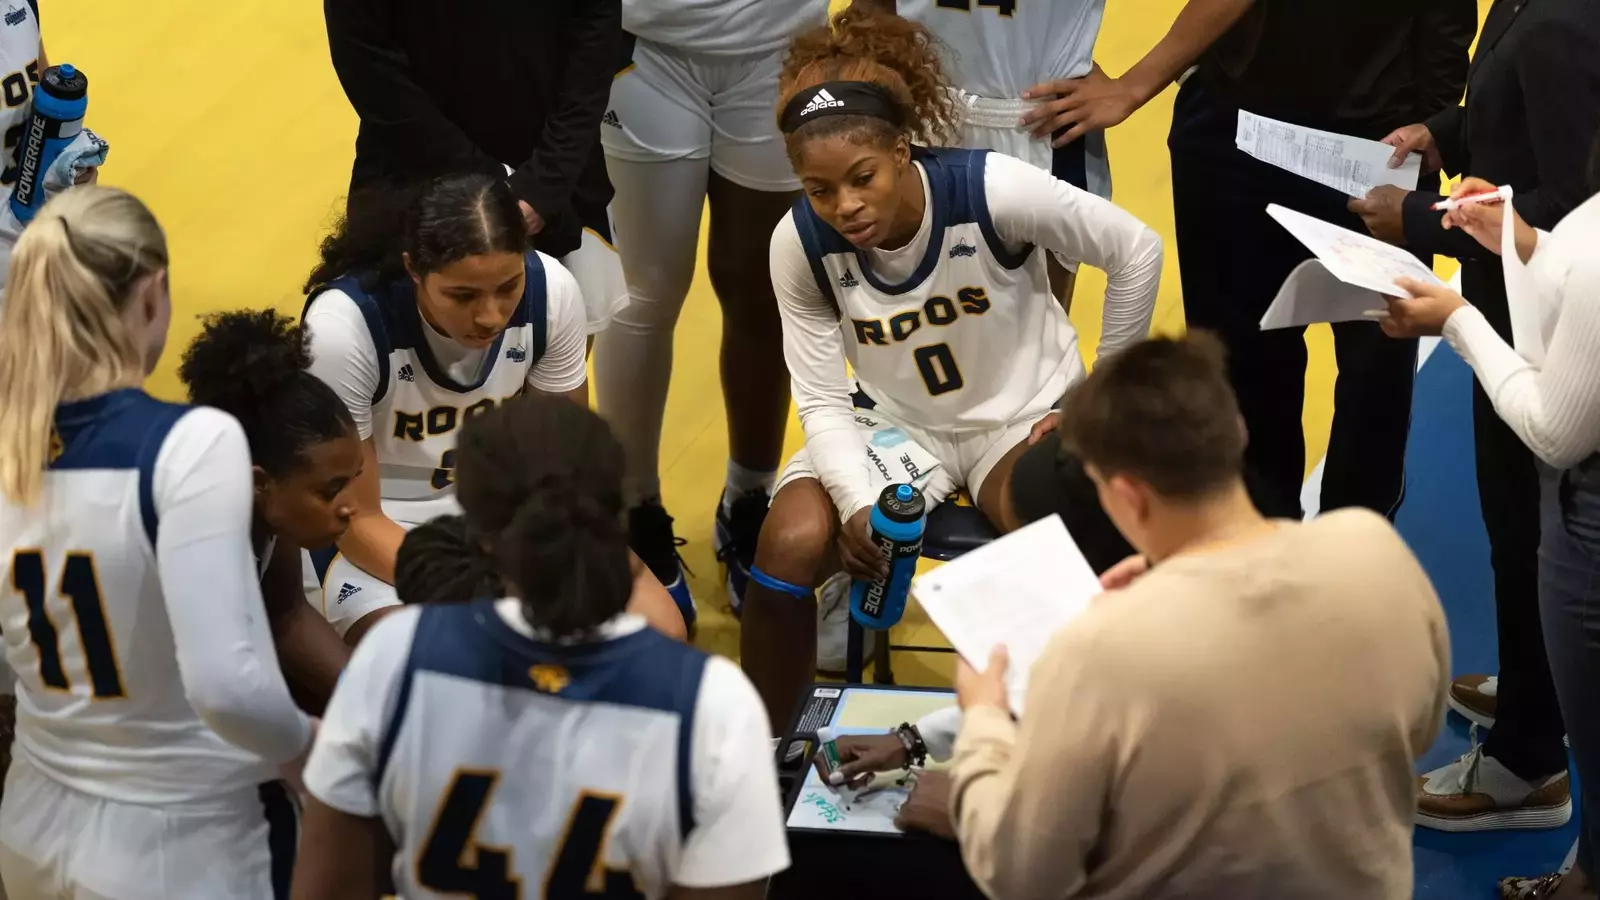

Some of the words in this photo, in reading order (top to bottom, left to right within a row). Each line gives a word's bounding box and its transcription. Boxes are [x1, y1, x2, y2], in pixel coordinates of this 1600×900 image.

[800, 100, 845, 116] adidas
[16, 115, 46, 204] POWERADE
[852, 286, 991, 345] ROOS
[913, 342, 964, 396] 0
[9, 548, 129, 702] 11
[415, 765, 650, 900] 44
